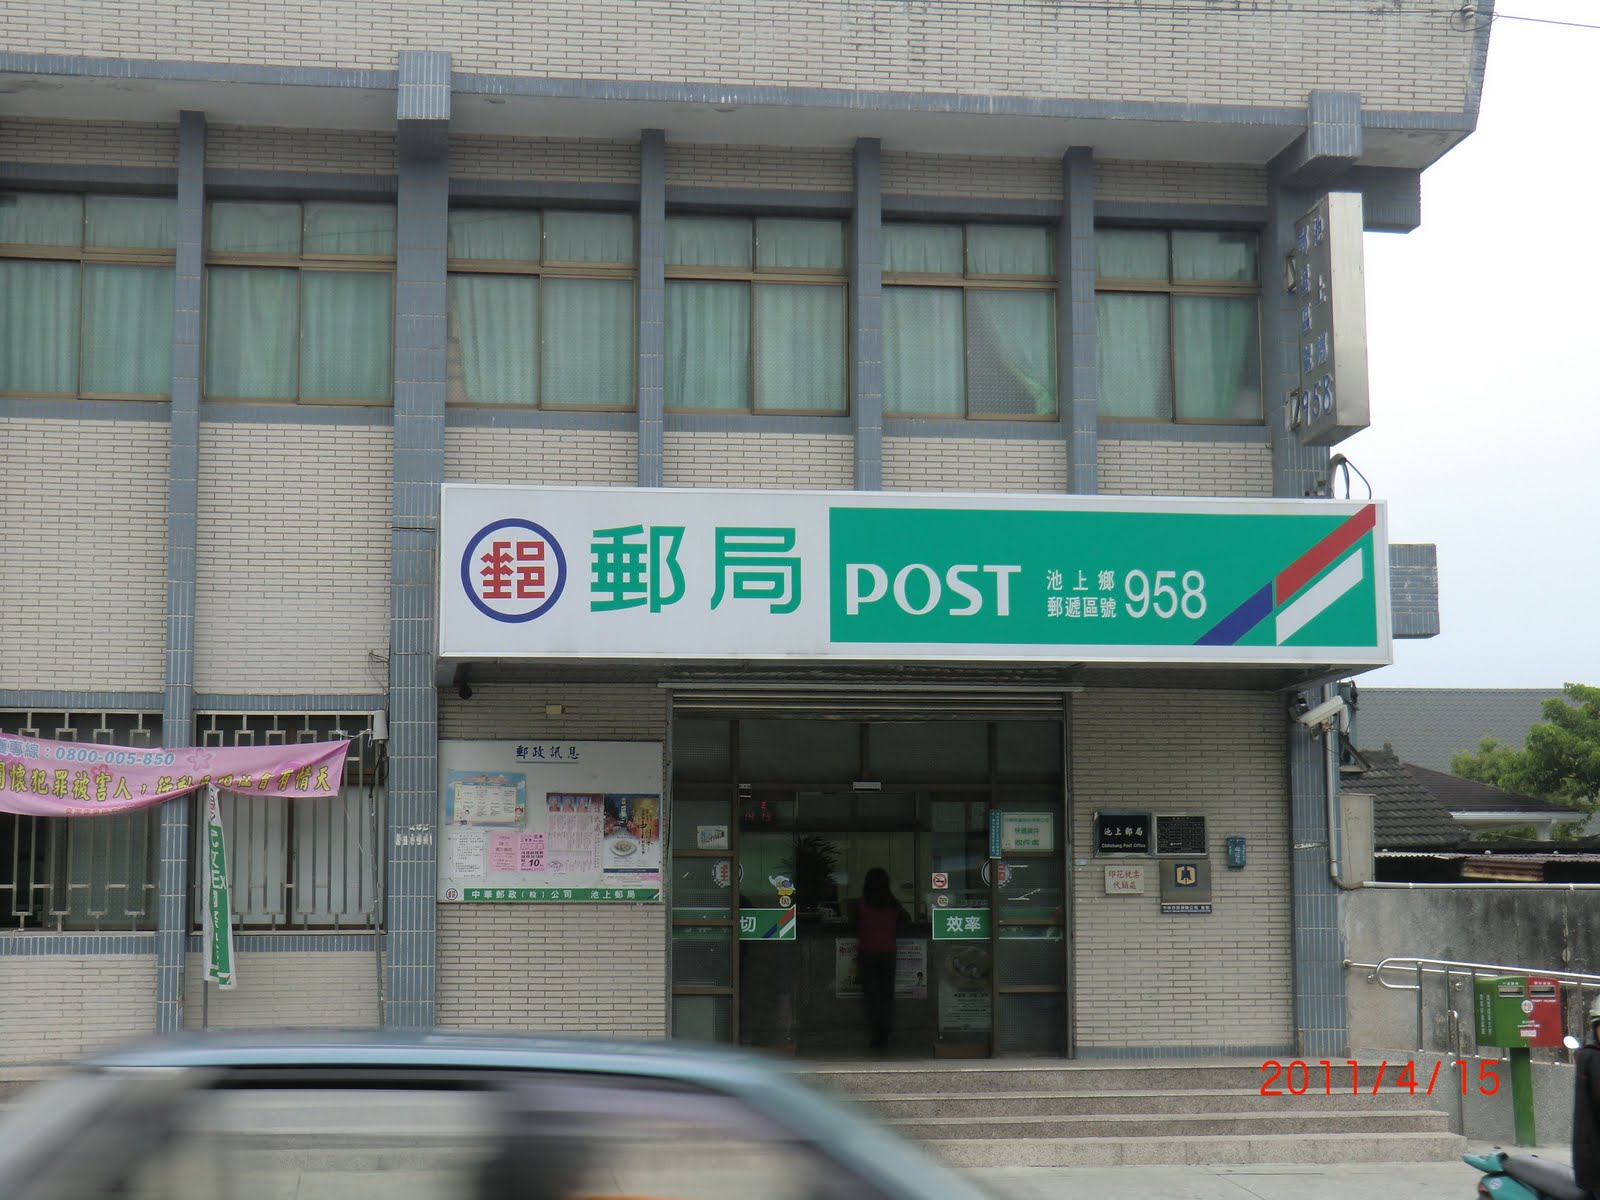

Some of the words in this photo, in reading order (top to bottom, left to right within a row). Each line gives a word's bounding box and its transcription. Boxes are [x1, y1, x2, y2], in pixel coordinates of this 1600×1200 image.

[1301, 373, 1333, 425] 958
[590, 524, 802, 615] 郵局
[1046, 569, 1115, 592] 池上鄉
[846, 562, 1022, 617] POST
[1046, 596, 1118, 619] 郵遞區號
[1123, 569, 1208, 619] 958
[515, 745, 580, 760] 郵政訊息
[945, 915, 982, 933] 效率
